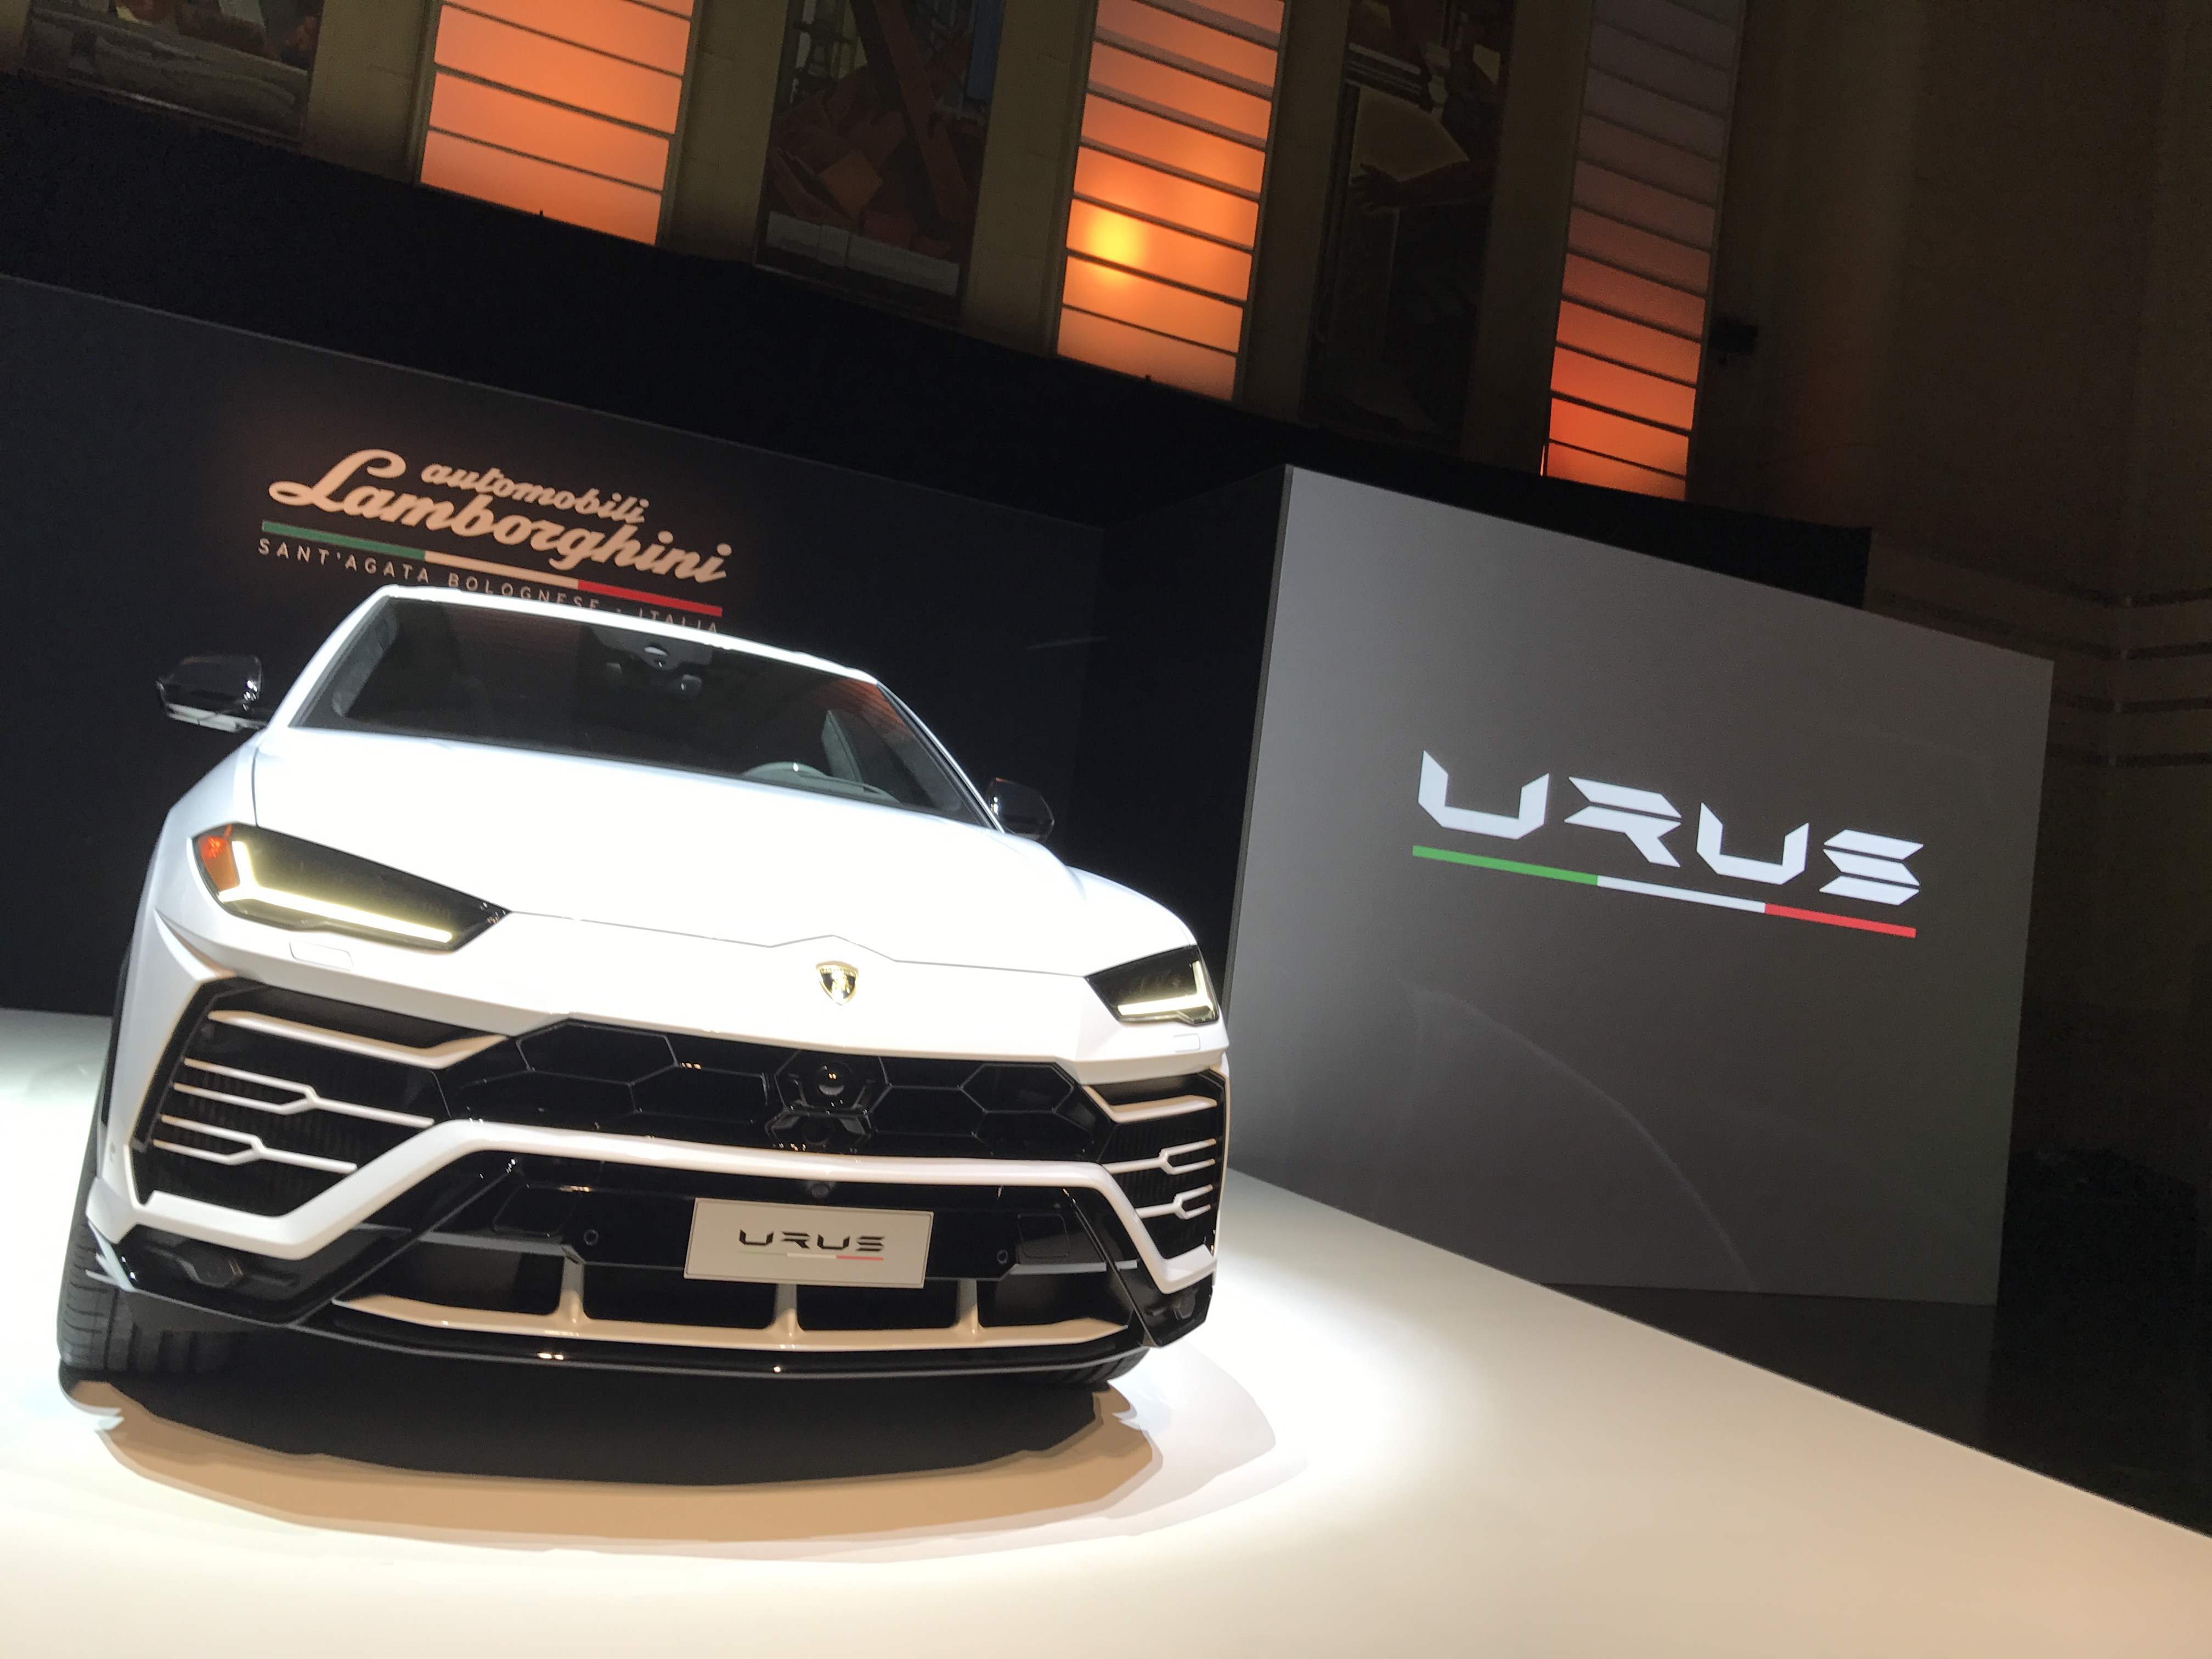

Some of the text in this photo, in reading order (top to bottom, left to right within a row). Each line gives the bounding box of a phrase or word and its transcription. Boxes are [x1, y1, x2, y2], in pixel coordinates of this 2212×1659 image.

[268, 448, 732, 584] Lamborghini
[421, 463, 650, 524] automobili
[258, 538, 429, 583] SANT'AGATA
[1417, 749, 1924, 906] URUS
[738, 1229, 885, 1252] URUS
